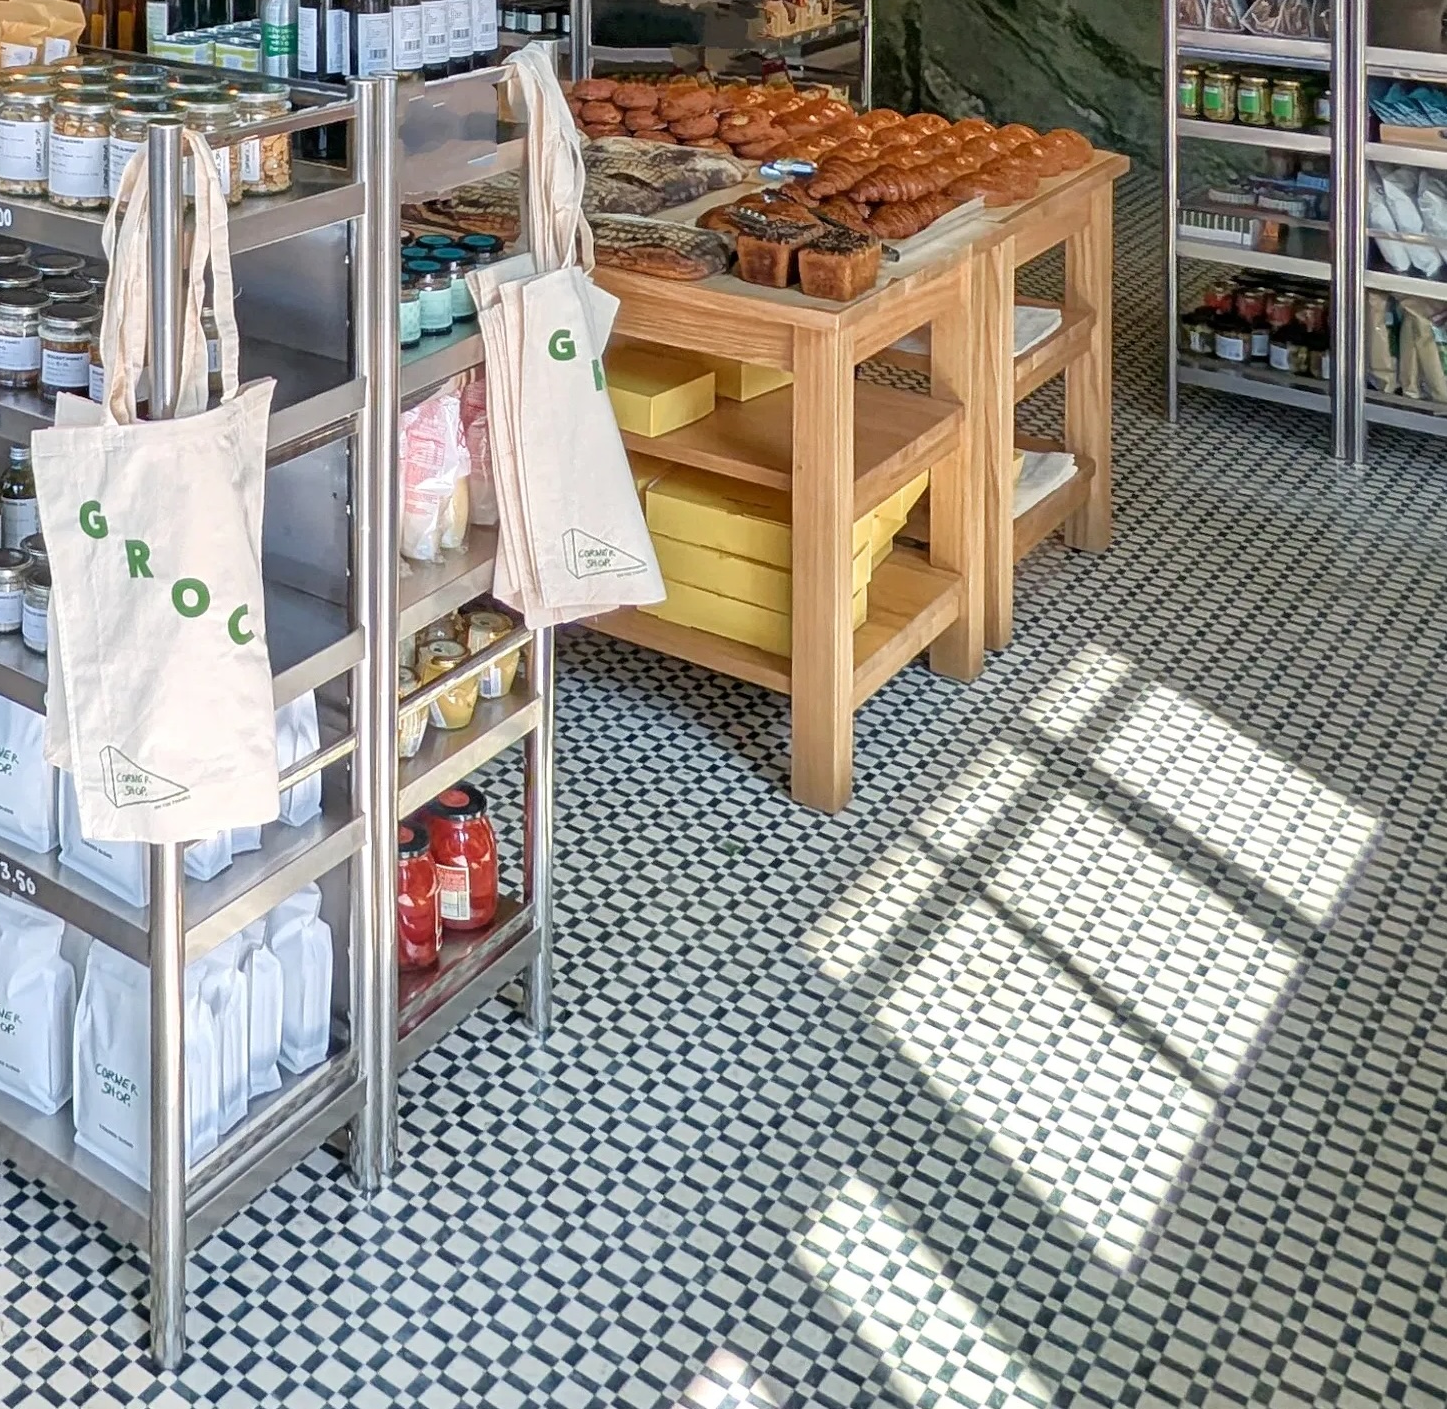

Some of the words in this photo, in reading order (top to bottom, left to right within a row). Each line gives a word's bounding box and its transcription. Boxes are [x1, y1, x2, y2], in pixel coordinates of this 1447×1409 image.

[578, 549, 616, 558] CORNER
[116, 773, 152, 784] CORNER
[95, 1063, 139, 1097] CORNER
